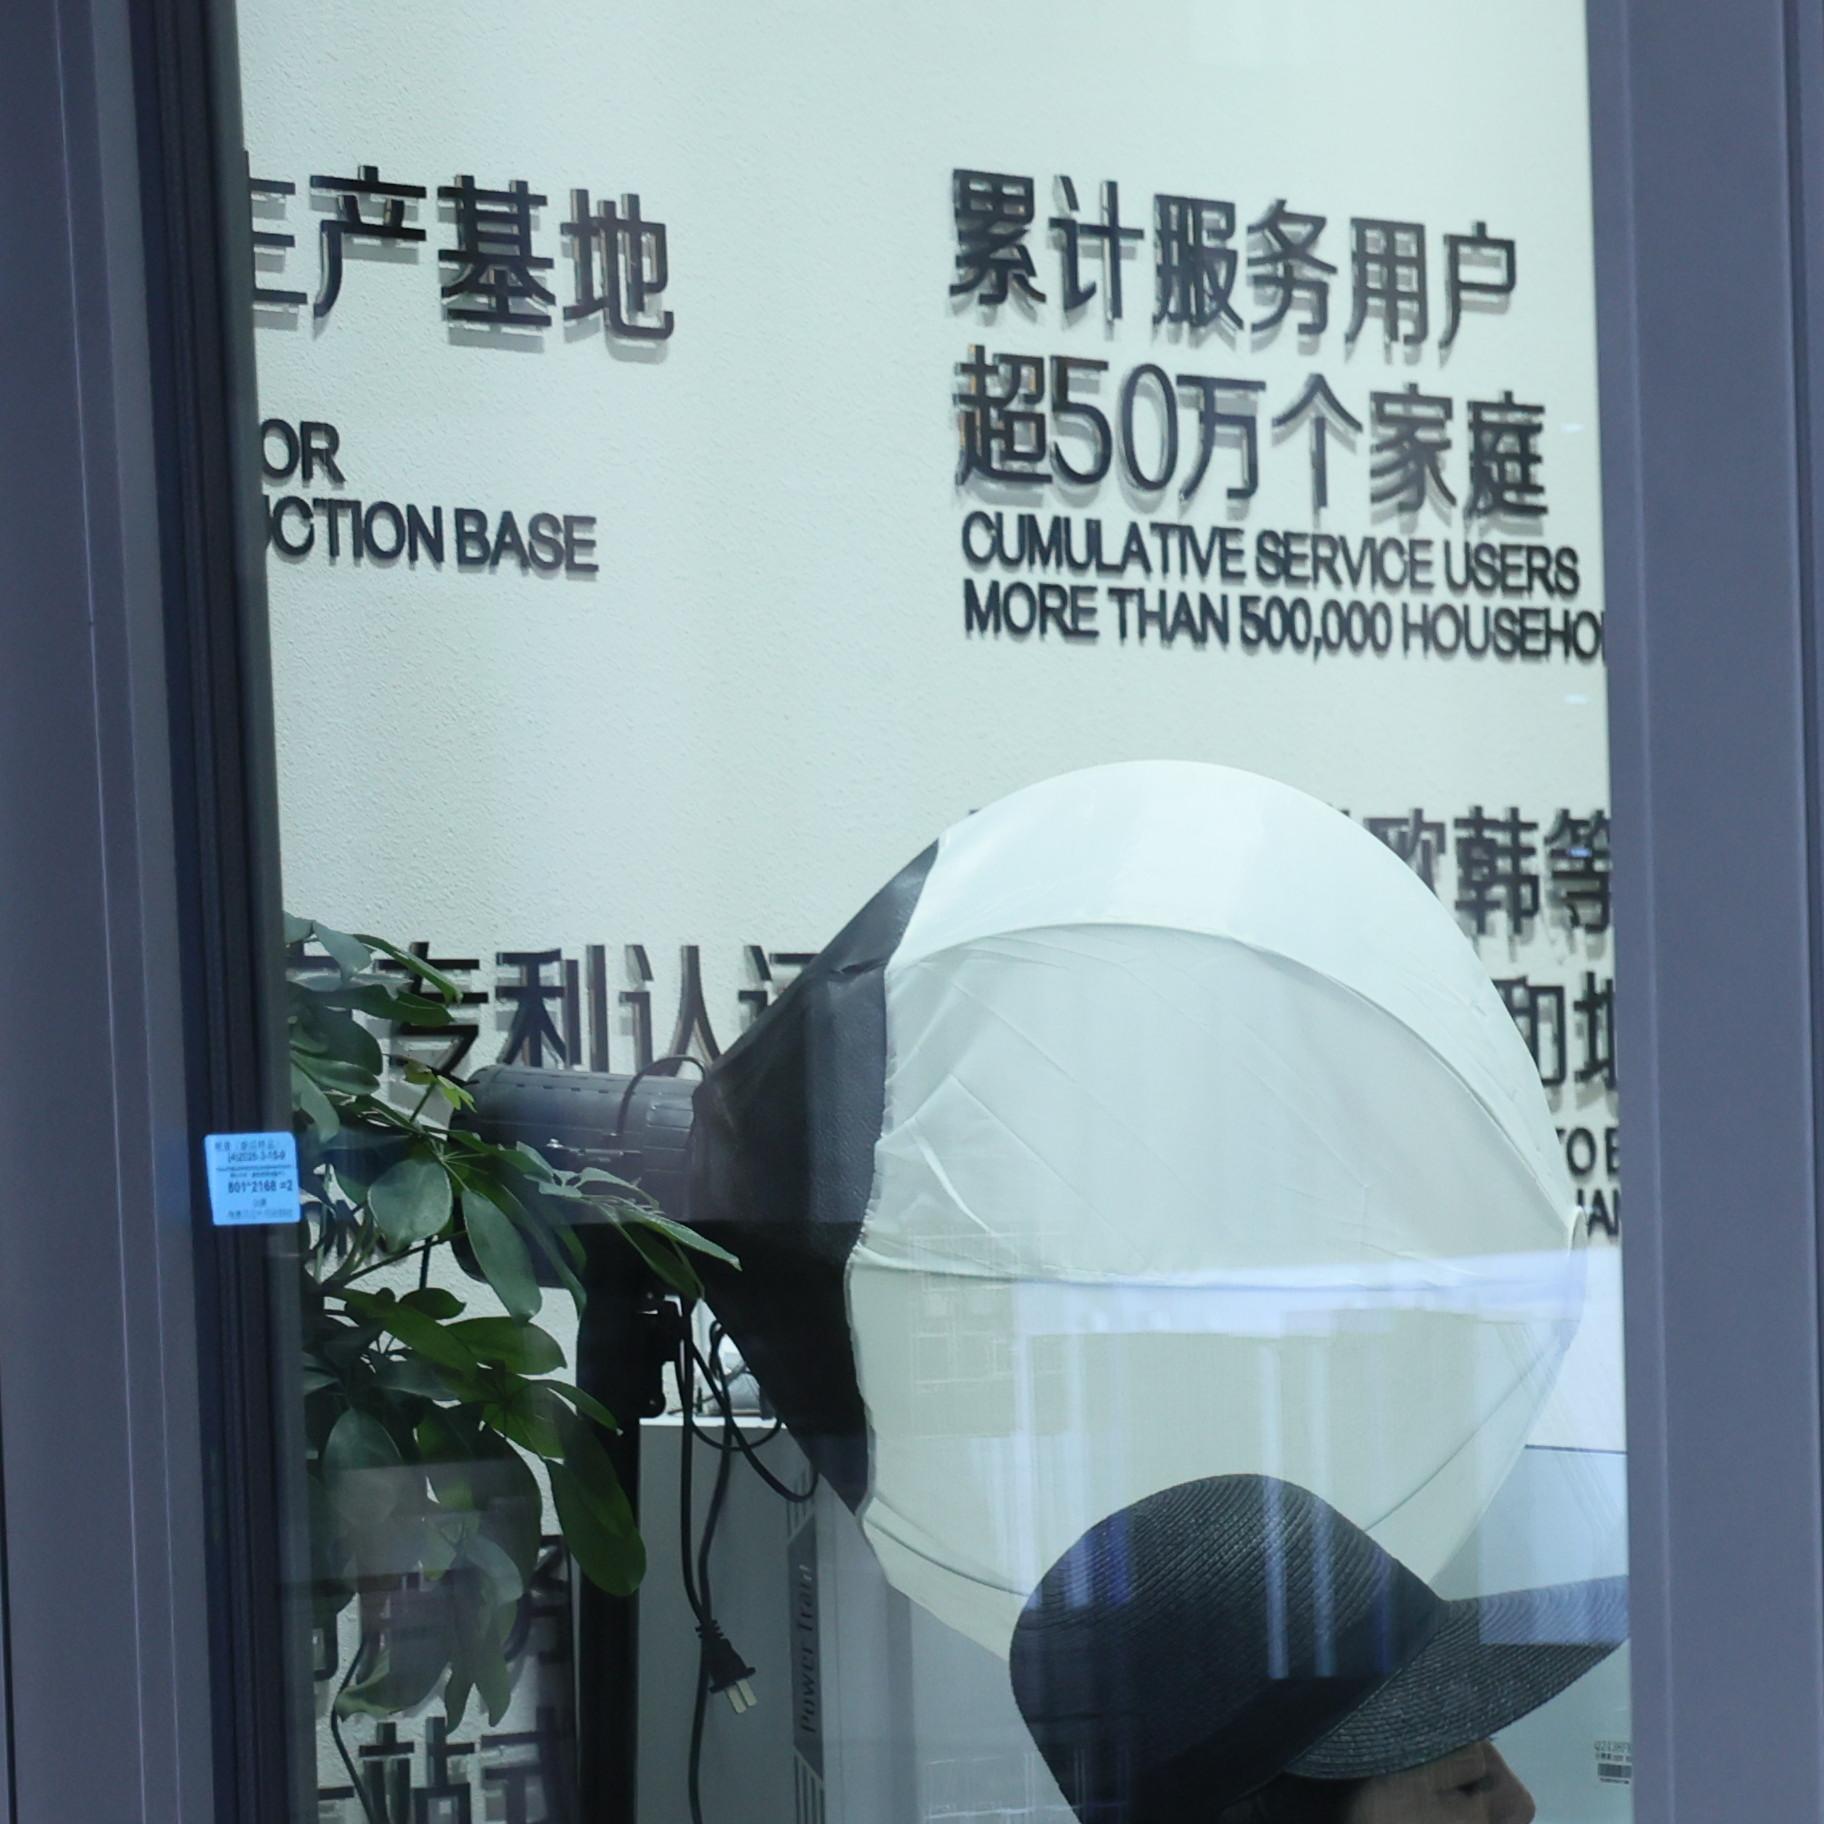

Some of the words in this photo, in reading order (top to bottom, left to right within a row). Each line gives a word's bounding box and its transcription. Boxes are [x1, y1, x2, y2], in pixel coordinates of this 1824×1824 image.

[949, 168, 1518, 349] 累计服务用户
[952, 343, 1549, 517] 超50万个家庭
[265, 495, 443, 566] CTION
[454, 507, 599, 574] BASE
[961, 511, 1246, 580] CUMULATIVE
[1255, 530, 1435, 590] SERVICE
[1443, 542, 1580, 596] USERS
[963, 579, 1099, 639] MORE
[1108, 588, 1229, 645] THAN
[1239, 595, 1393, 661] 500,000
